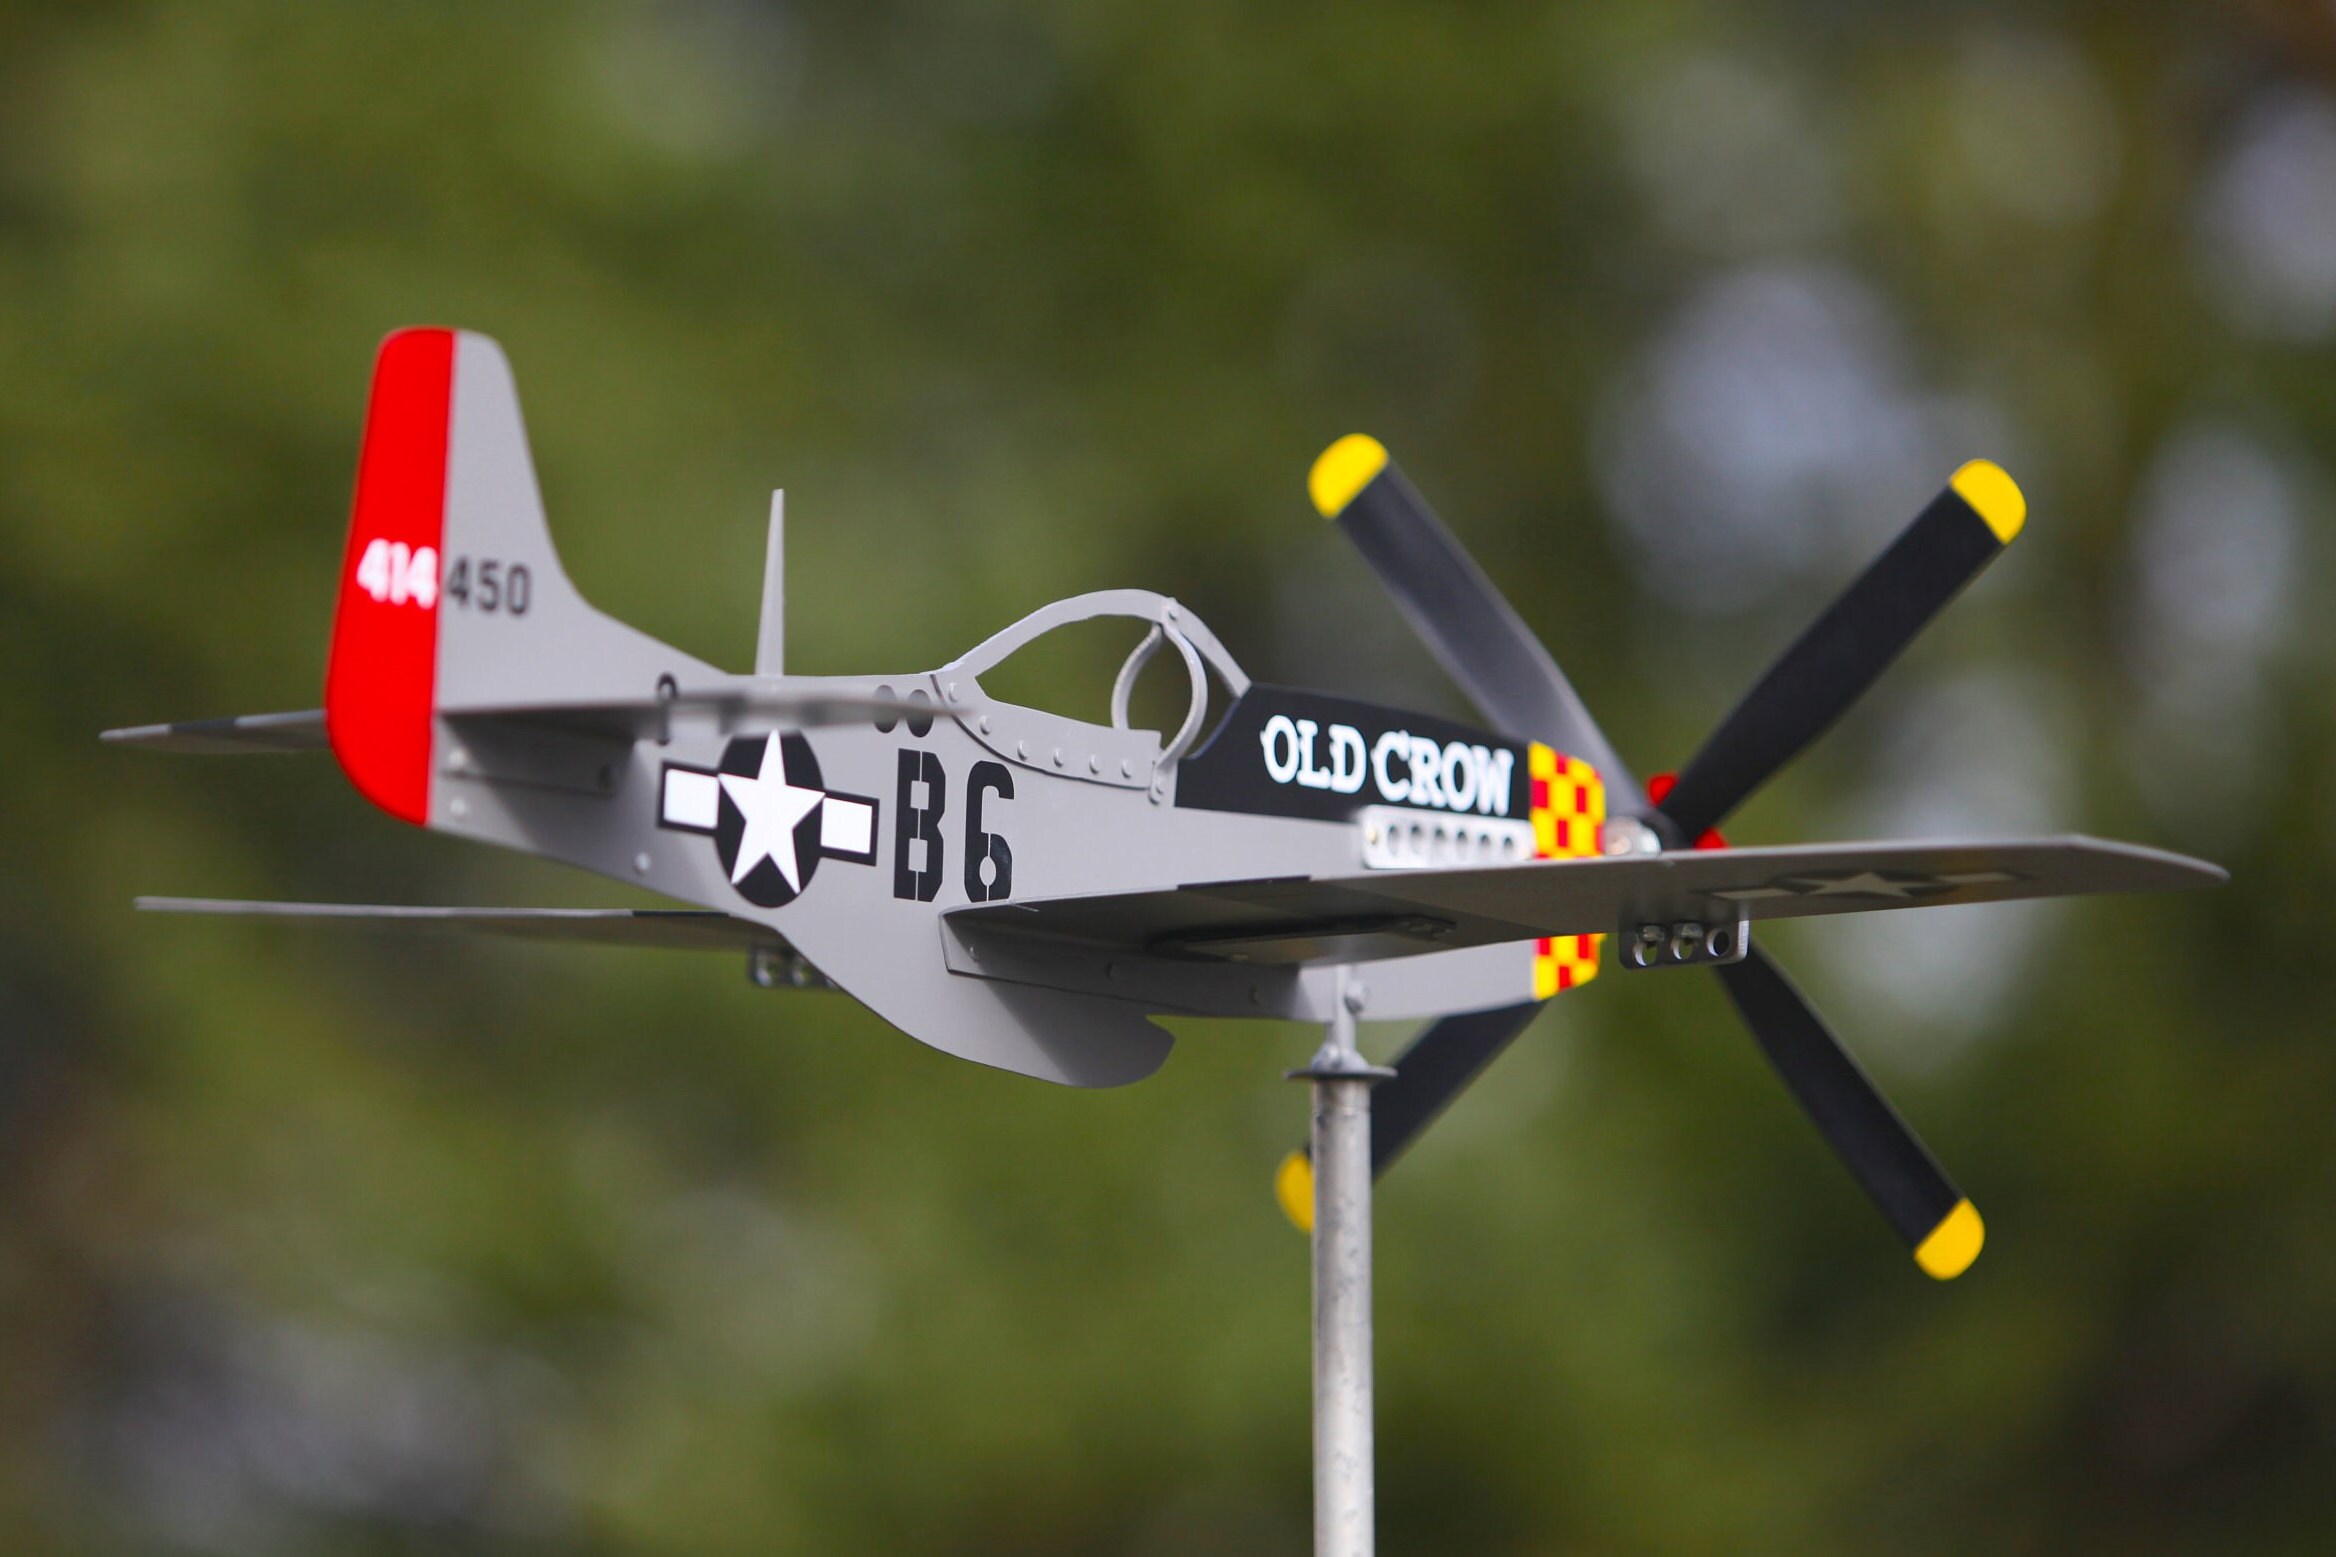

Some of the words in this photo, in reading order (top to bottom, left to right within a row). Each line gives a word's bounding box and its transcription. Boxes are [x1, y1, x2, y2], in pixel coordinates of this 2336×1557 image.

[356, 538, 438, 609] 414
[447, 553, 530, 617] 450
[1260, 714, 1367, 794] OLD
[1371, 729, 1515, 817] CROW
